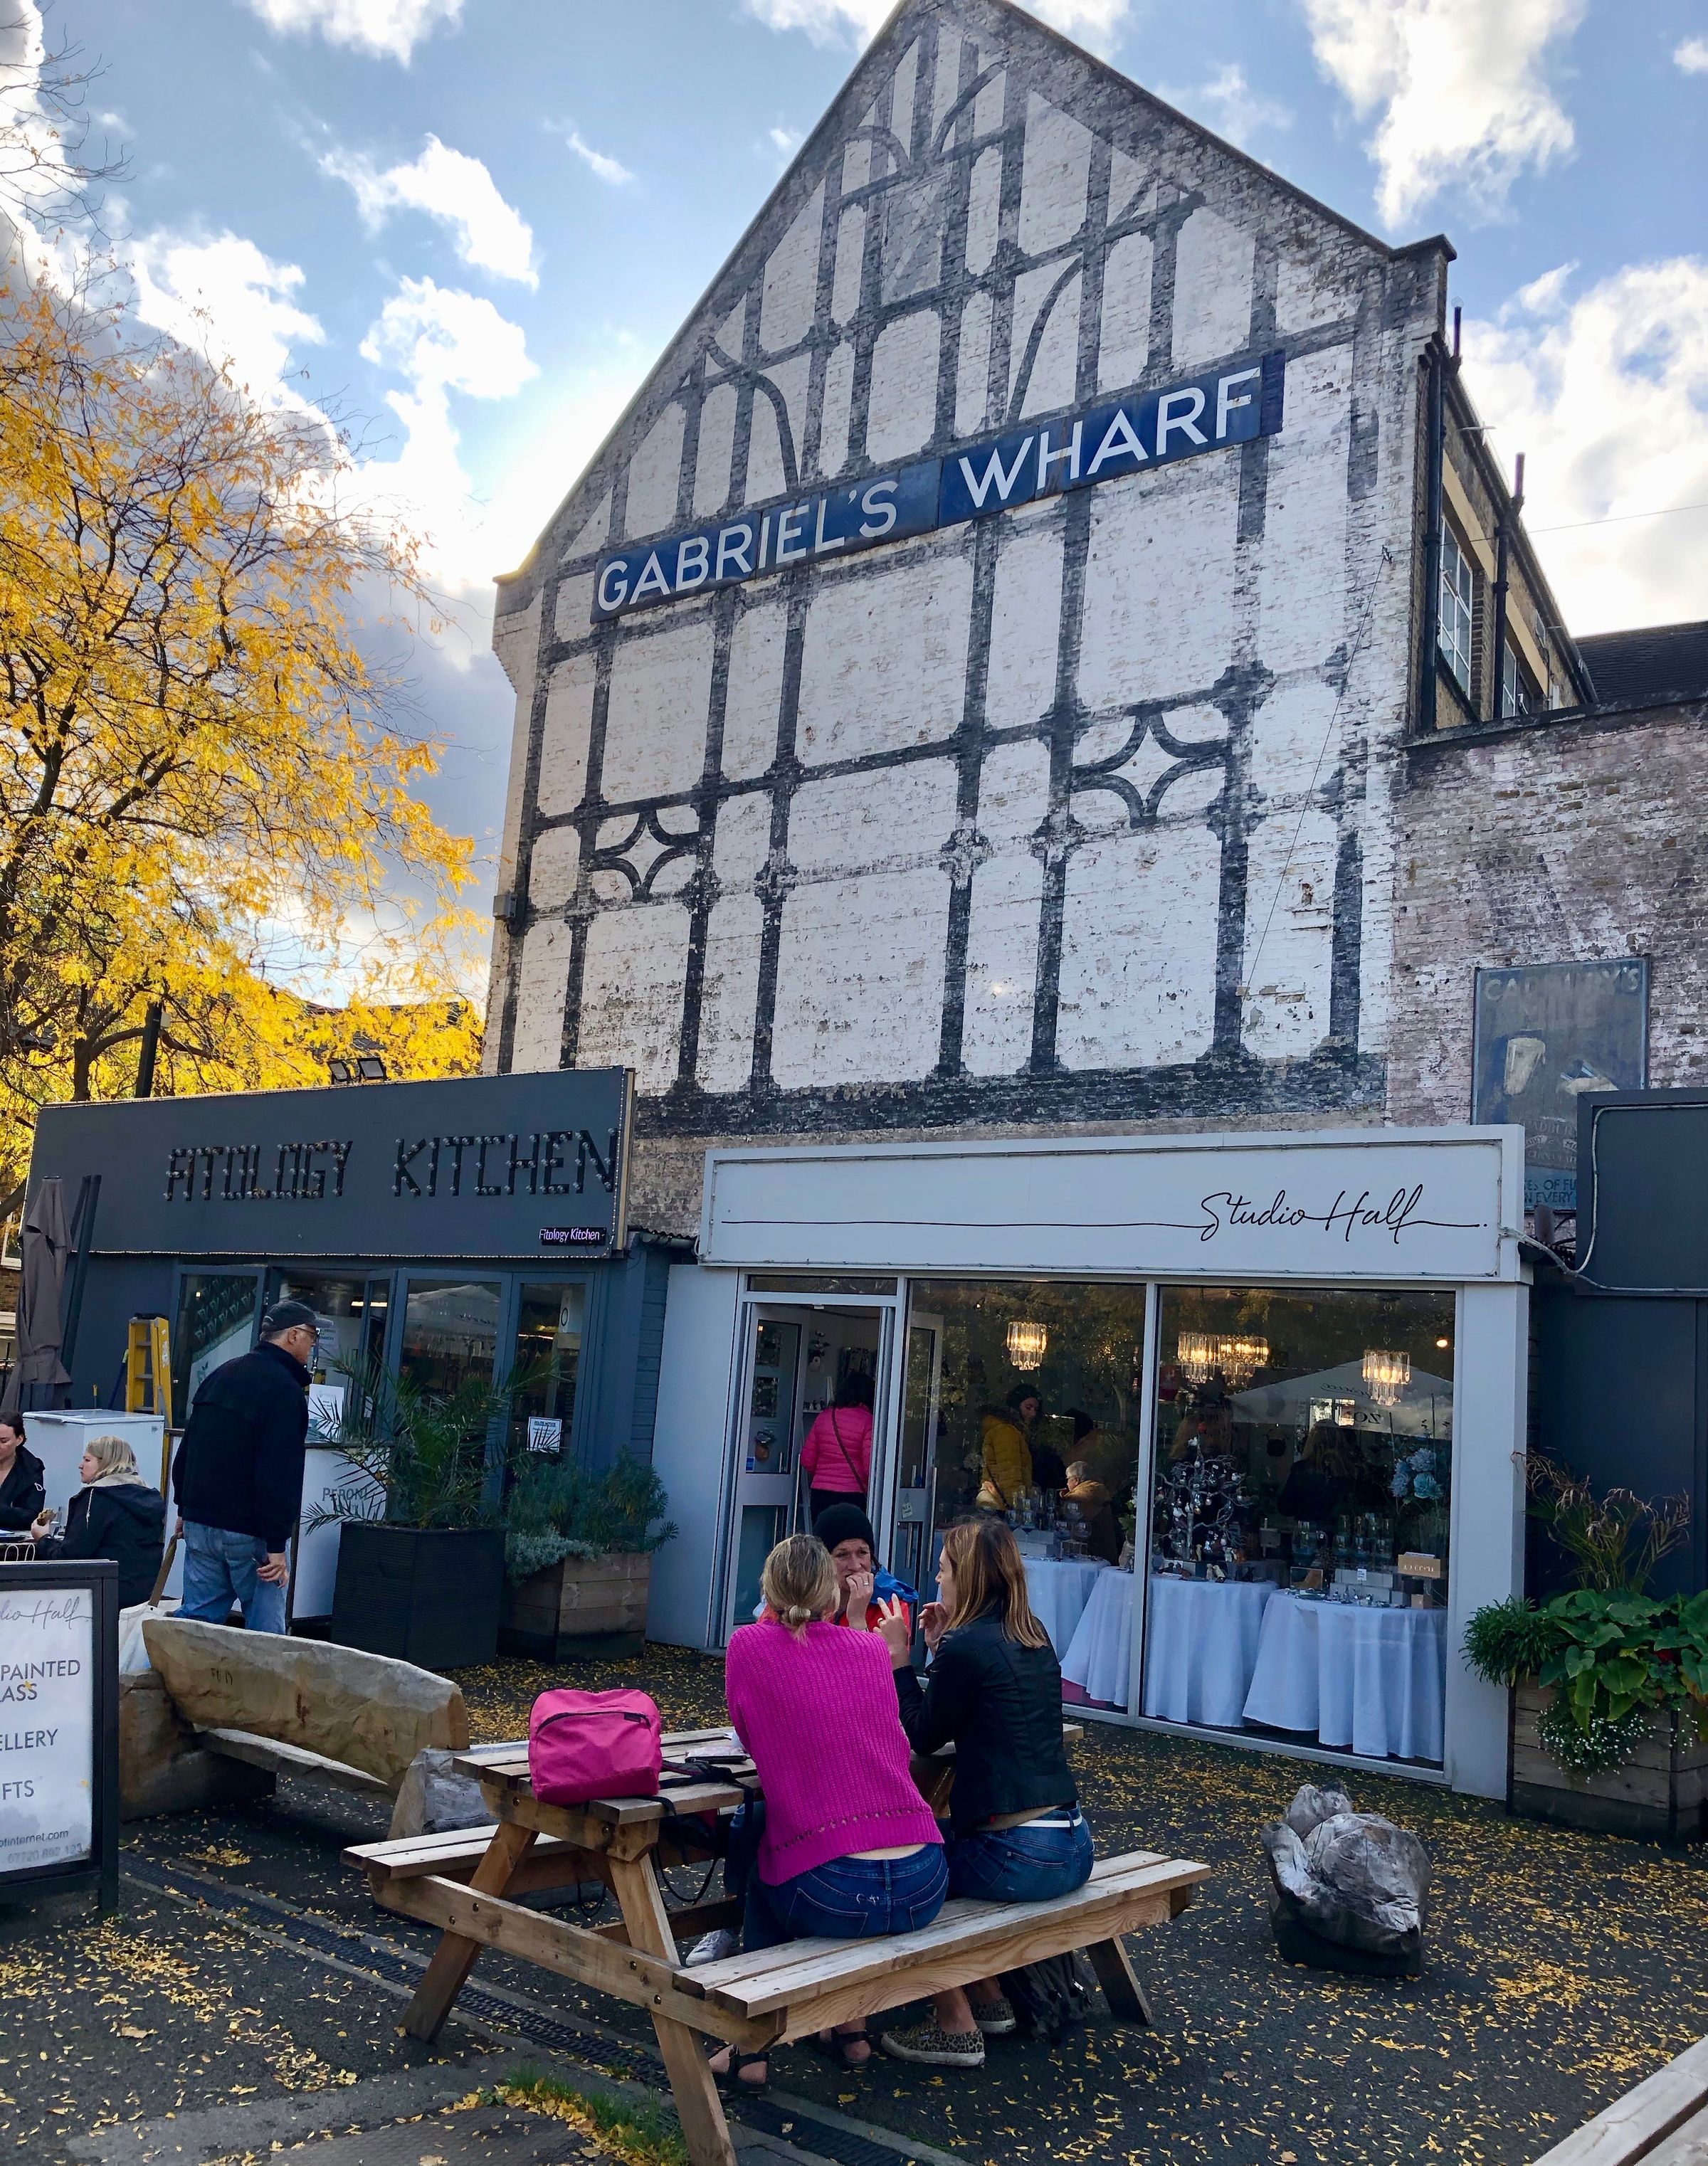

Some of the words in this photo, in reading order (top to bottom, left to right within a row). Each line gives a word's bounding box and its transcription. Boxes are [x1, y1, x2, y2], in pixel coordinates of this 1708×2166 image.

[596, 480, 898, 613] GABRIEL'S
[958, 367, 1260, 507] WHARF
[163, 1140, 354, 1202] FITOLOGY
[393, 1129, 618, 1198] KITCHEN
[1544, 1178, 1561, 1190] OF
[1536, 1191, 1573, 1203] EVERY
[1201, 1189, 1307, 1242] Studio
[539, 1227, 569, 1243] Fitology
[570, 1227, 600, 1240] Kitchen
[322, 1486, 368, 1501] PERONI
[1, 1659, 81, 1681] PAINTED
[0, 1682, 38, 1703] ASS
[2, 1780, 35, 1801] FTS
